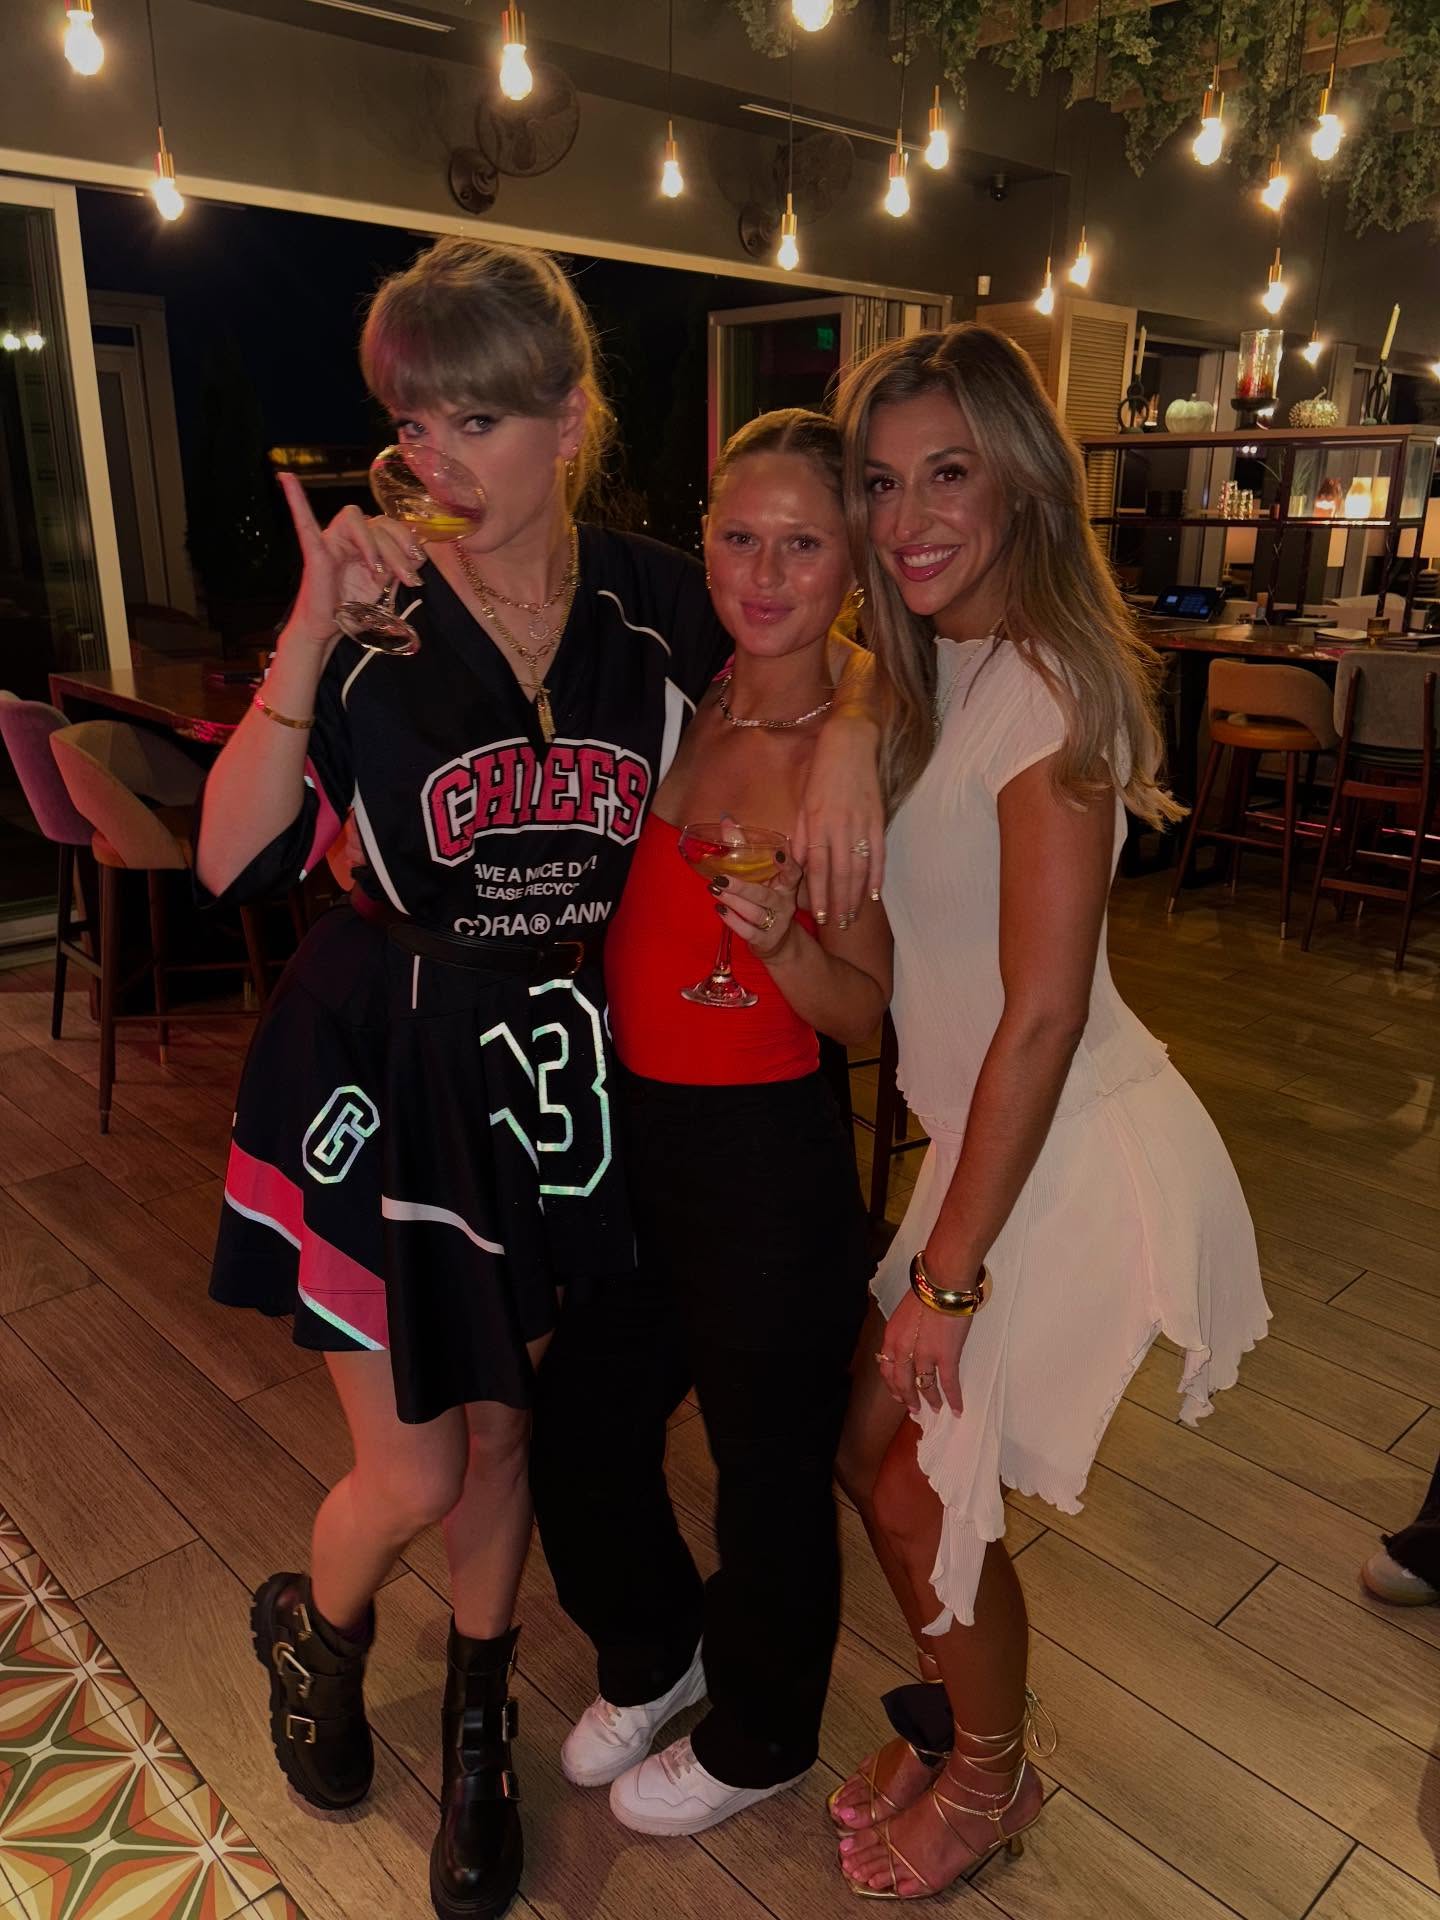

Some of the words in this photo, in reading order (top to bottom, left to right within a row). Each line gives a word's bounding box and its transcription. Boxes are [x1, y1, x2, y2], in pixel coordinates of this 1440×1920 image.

[420, 736, 651, 867] CHIEFS
[507, 867, 522, 883] A
[525, 862, 564, 882] NICE
[475, 884, 524, 900] LEASE
[524, 882, 580, 896] RECYC
[555, 901, 612, 926] ANN
